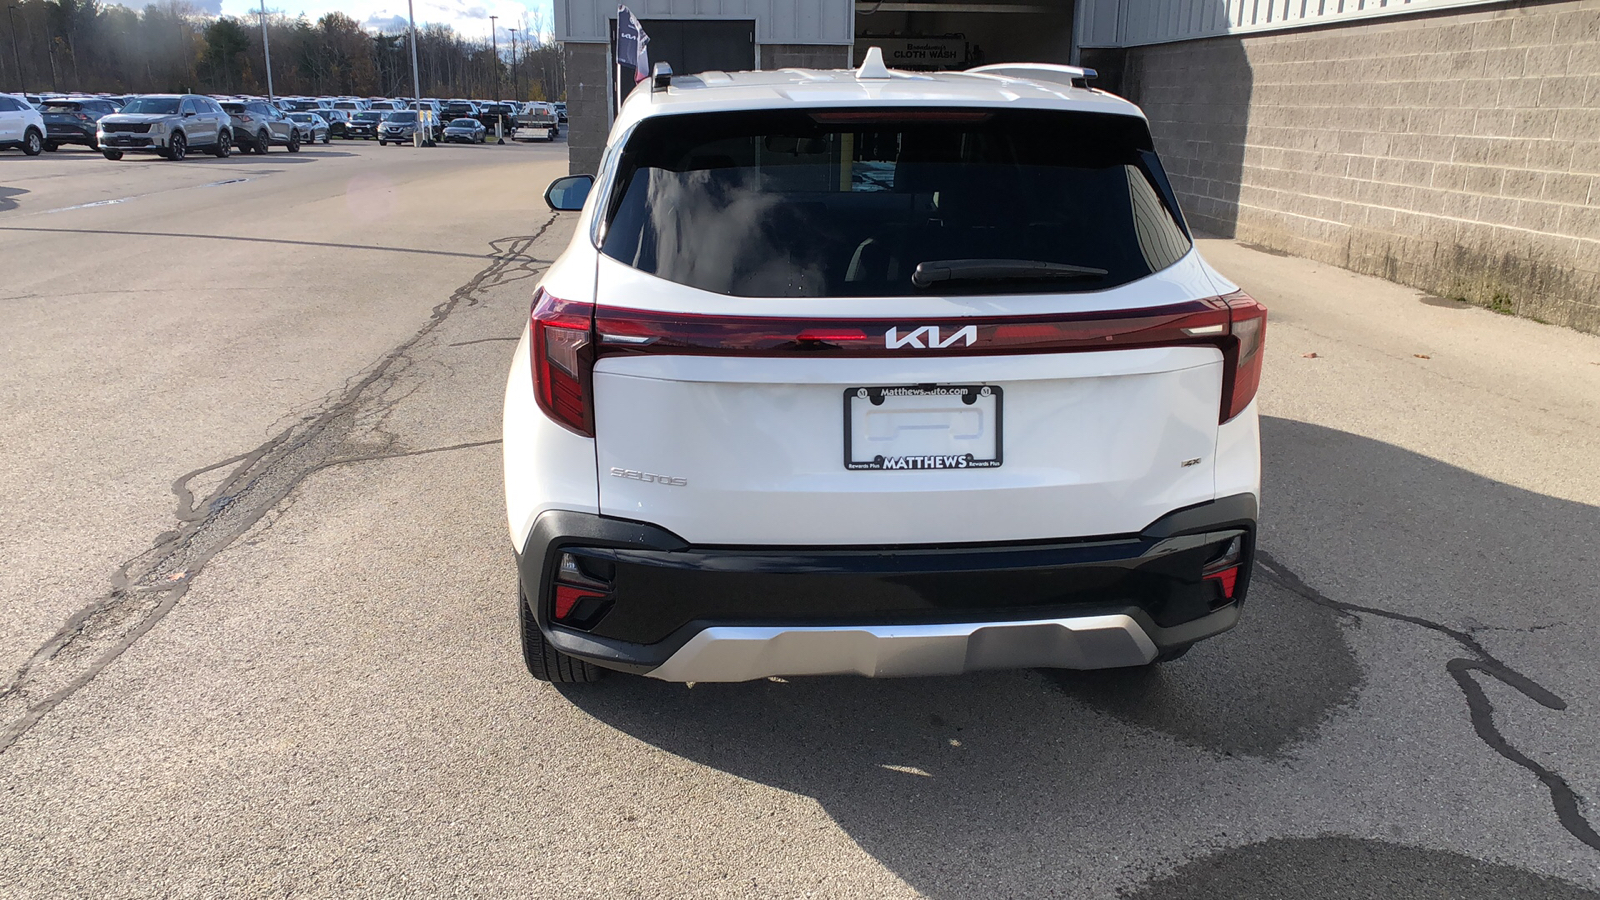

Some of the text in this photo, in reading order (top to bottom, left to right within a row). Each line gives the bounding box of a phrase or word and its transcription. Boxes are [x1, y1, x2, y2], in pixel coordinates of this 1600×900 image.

[893, 50, 957, 59] CLOTH WASH
[885, 325, 977, 349] KIA
[882, 455, 967, 469] MATTHEWS
[610, 466, 688, 487] SELTOS
